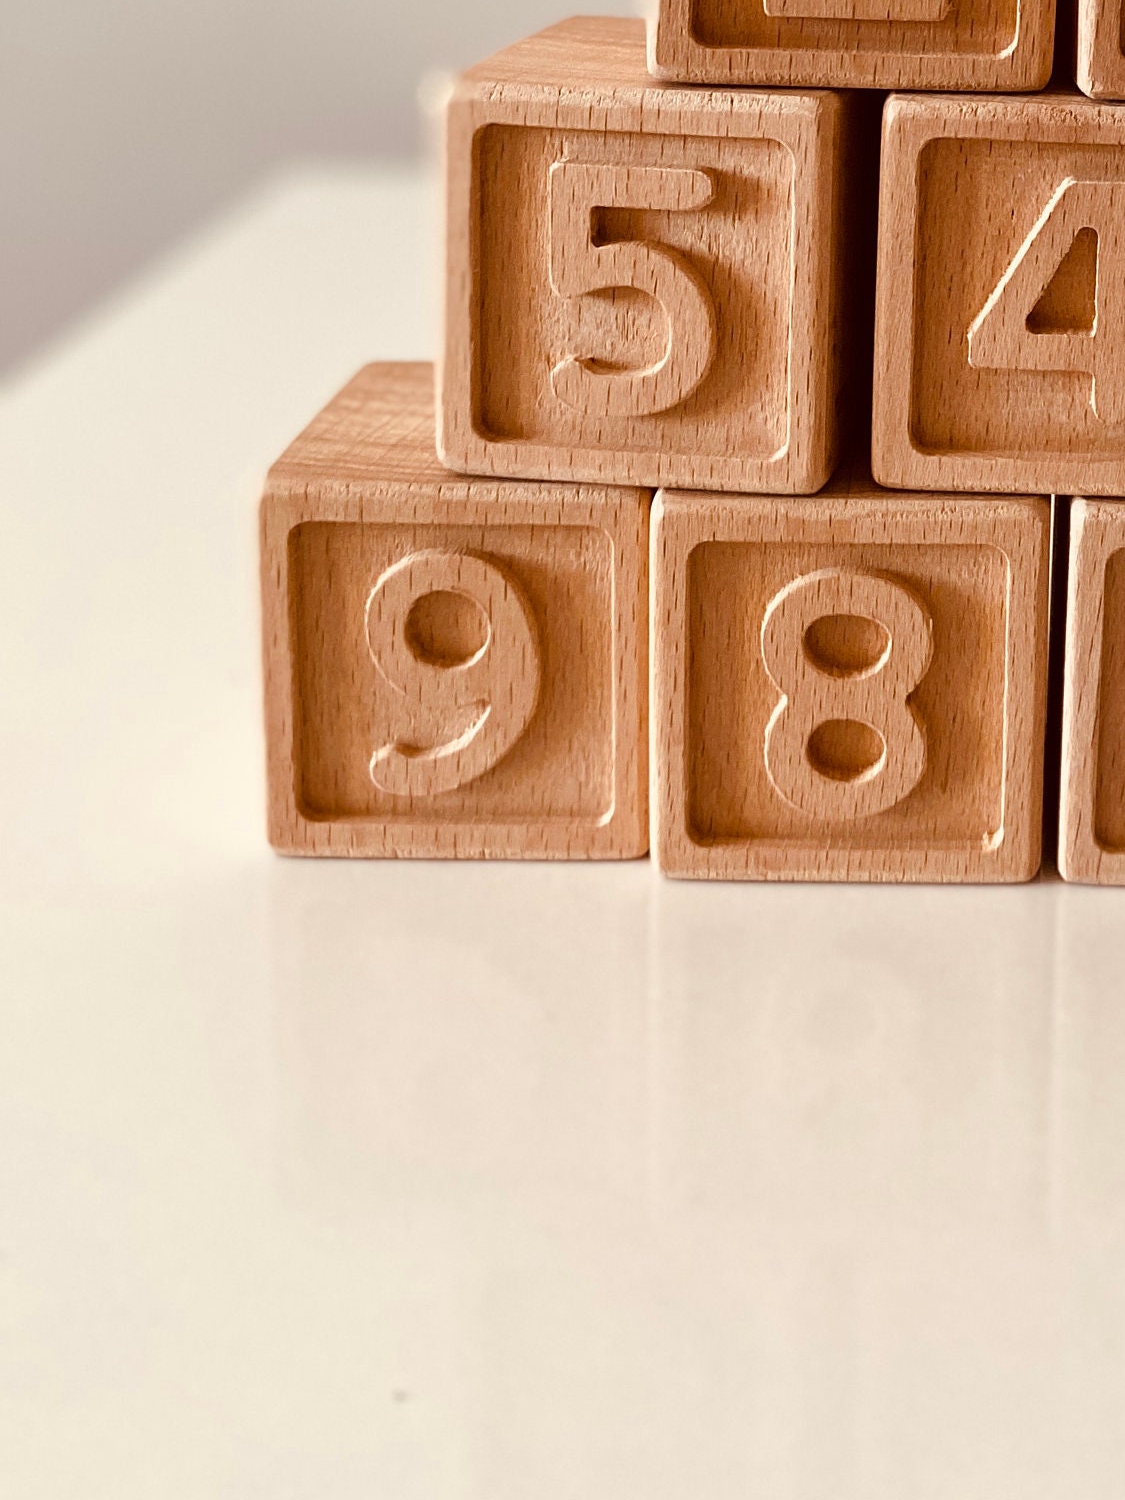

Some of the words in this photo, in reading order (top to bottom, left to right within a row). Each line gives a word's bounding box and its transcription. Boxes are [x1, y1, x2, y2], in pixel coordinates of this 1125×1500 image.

[548, 159, 719, 418] 5
[364, 546, 542, 797] 9
[760, 566, 935, 821] 8
